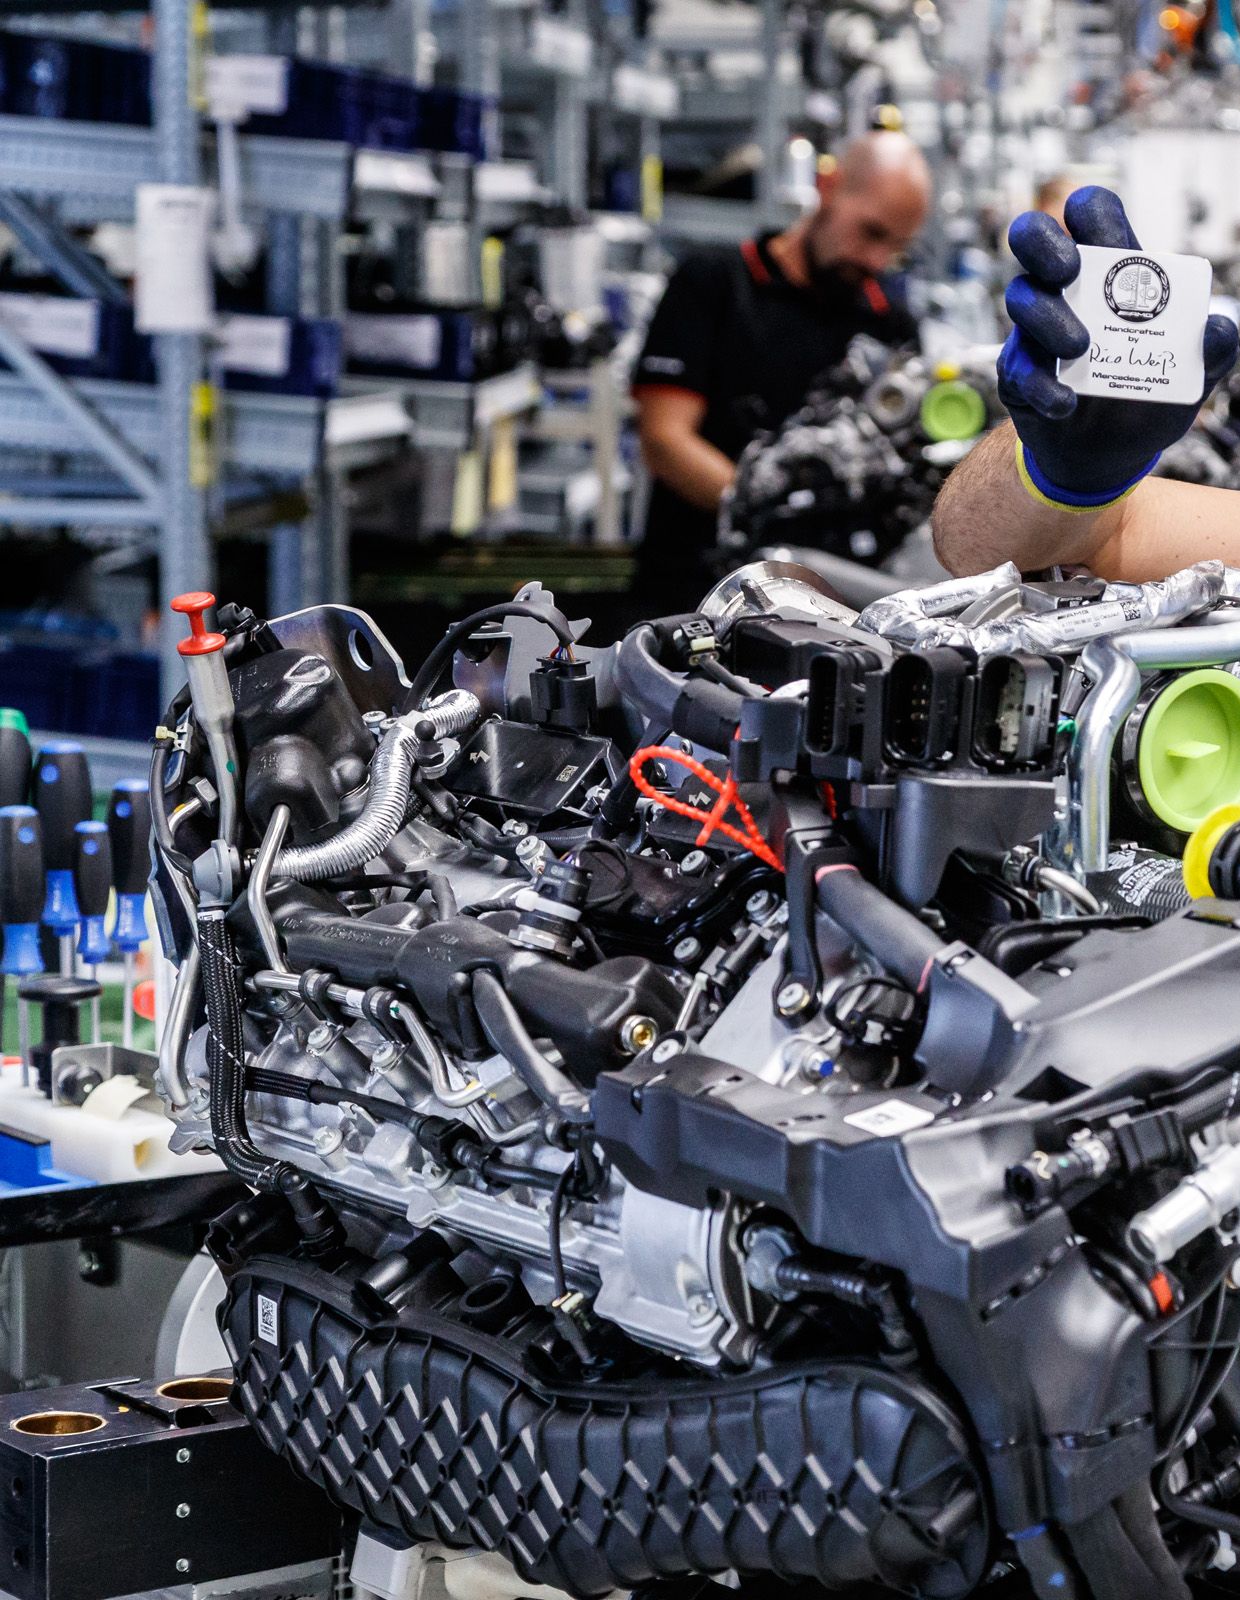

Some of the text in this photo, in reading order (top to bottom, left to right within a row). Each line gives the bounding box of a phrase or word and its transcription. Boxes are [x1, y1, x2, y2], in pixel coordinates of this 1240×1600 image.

[1104, 325, 1165, 336] Handcrafted
[1128, 336, 1139, 344] by
[1090, 342, 1122, 363] Rico
[1092, 372, 1170, 385] Mercedes-AMG
[1108, 382, 1152, 393] Germany
